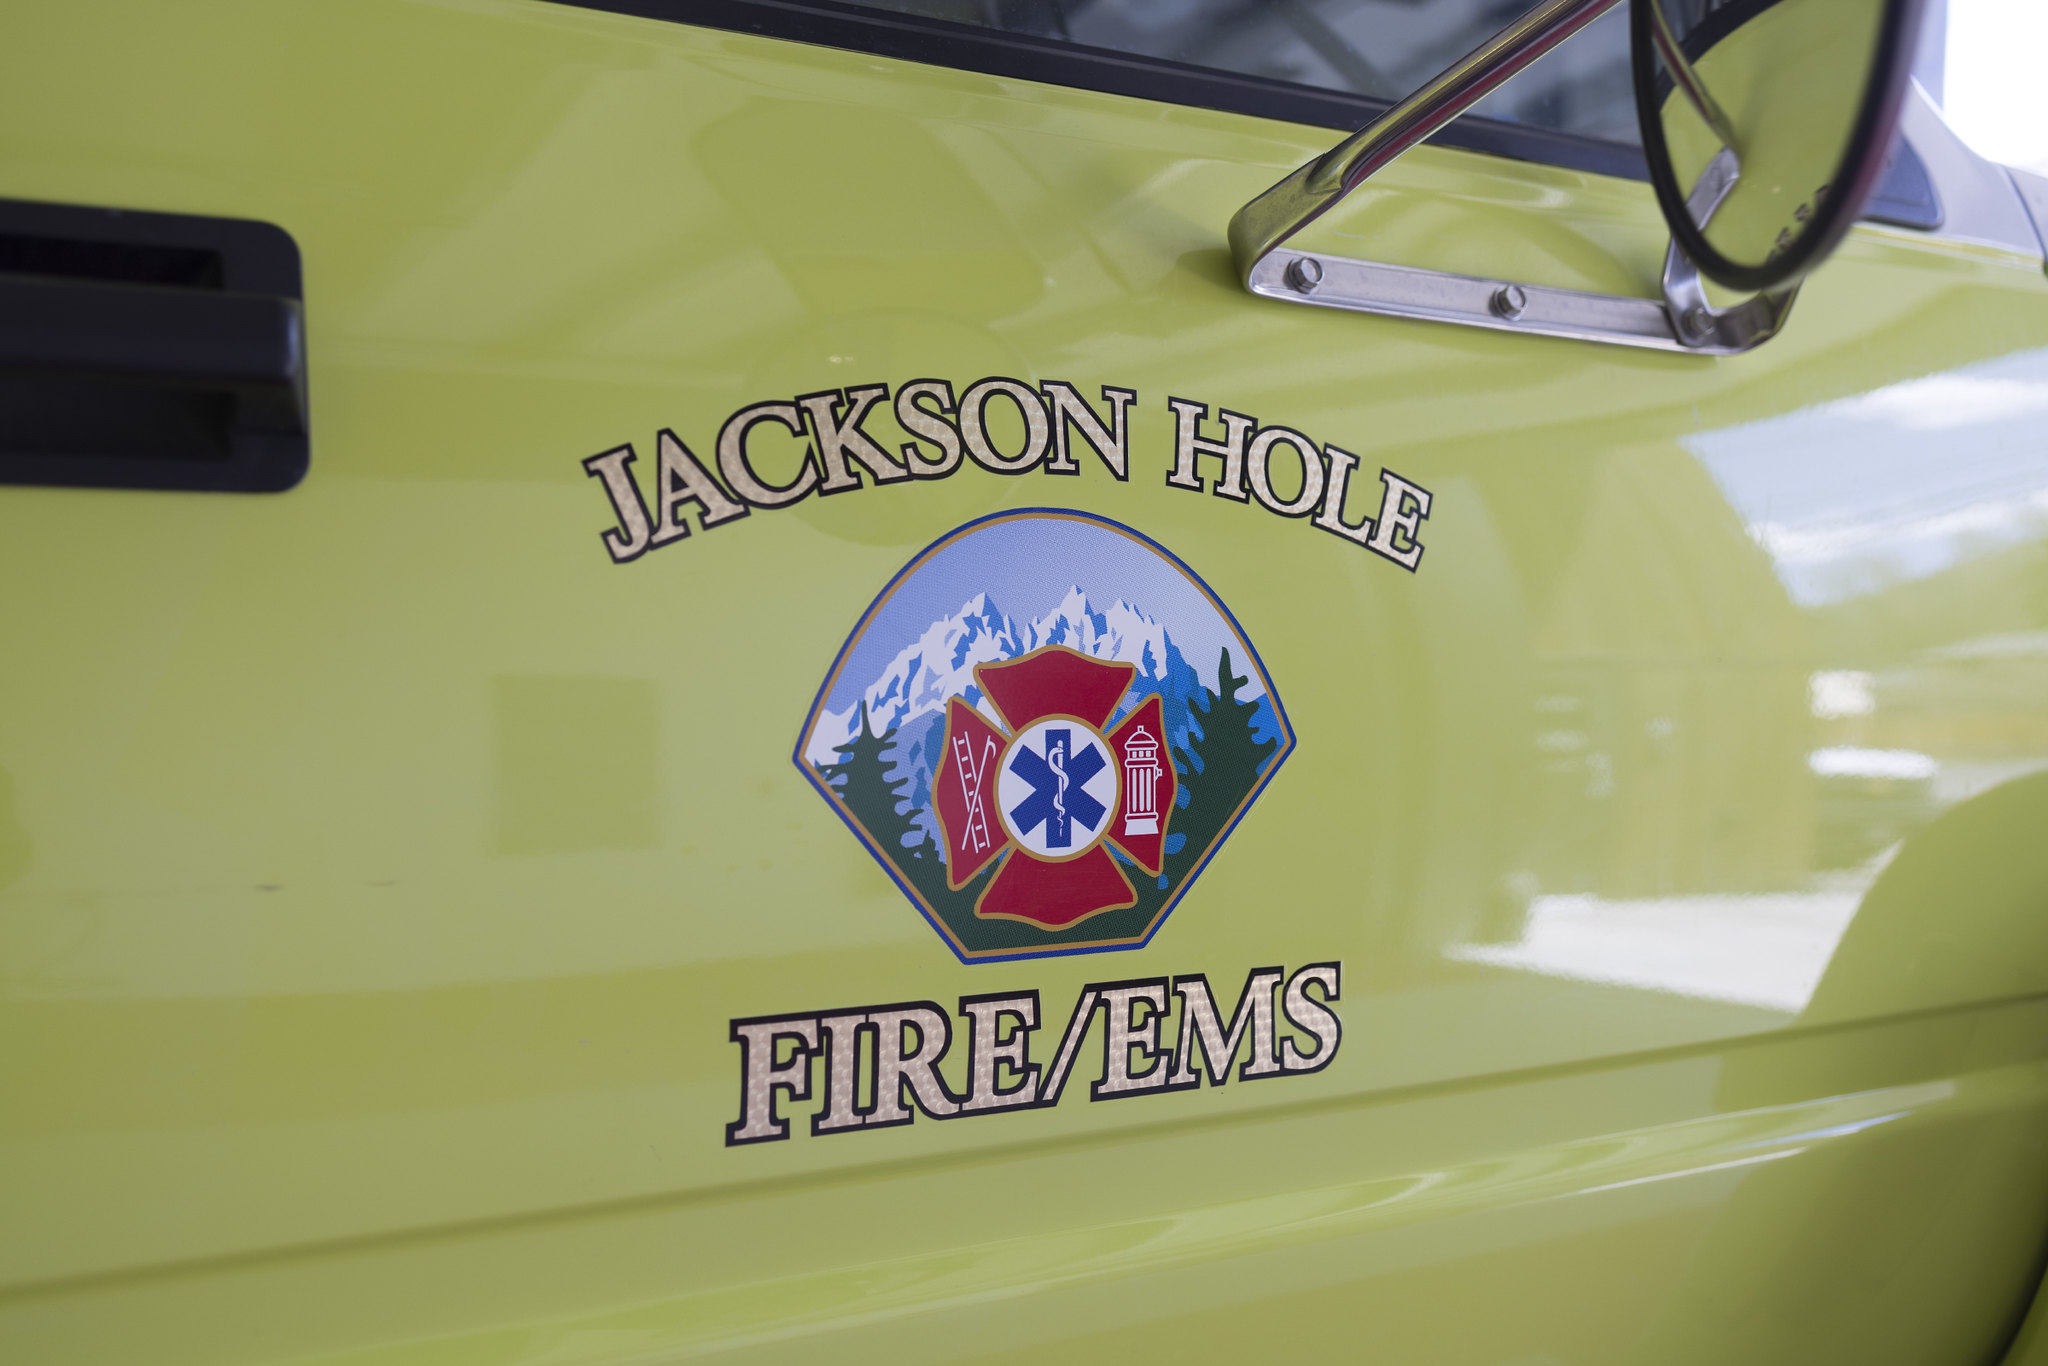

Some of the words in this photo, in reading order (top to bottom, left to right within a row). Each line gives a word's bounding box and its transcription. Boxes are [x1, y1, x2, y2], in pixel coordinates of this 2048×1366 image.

[583, 376, 1137, 564] JACKSON
[1166, 395, 1433, 572] HOLE
[725, 961, 1342, 1147] FIRE/EMS
